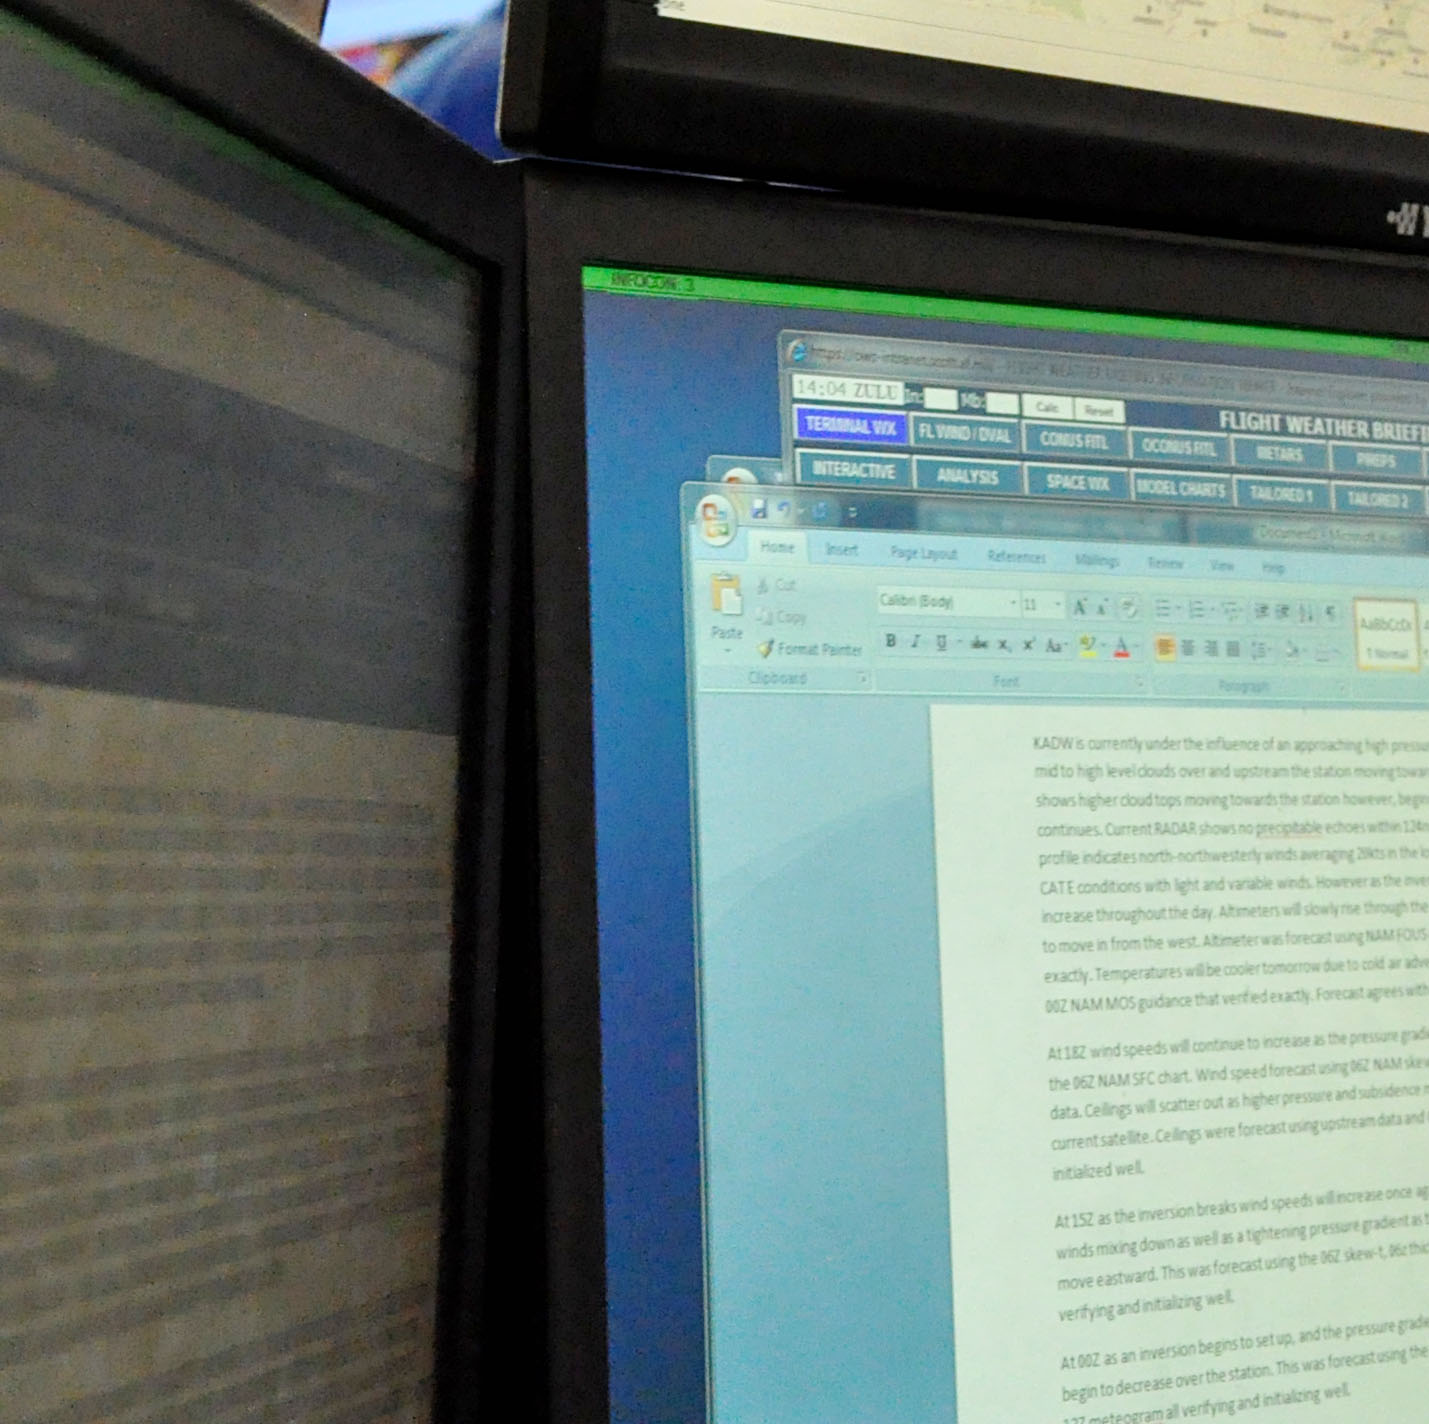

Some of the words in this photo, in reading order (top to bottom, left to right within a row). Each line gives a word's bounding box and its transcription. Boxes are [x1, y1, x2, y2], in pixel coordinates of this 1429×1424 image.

[797, 377, 847, 398] 14:04
[853, 381, 899, 401] ZULU
[805, 414, 872, 436] TERMINAL
[874, 419, 898, 436] WX
[1218, 410, 1282, 433] FLIGHT
[1284, 413, 1371, 440] WEATHER
[1040, 431, 1082, 449] CONUS
[812, 459, 897, 480] INTERACTIVE
[937, 466, 999, 486] ANALYSIS
[1046, 473, 1087, 491] SPACE
[1088, 476, 1111, 492] WX
[1136, 478, 1178, 496] MODEL
[1179, 480, 1226, 498] CHARTS
[760, 540, 796, 555] Home
[825, 542, 859, 556] Insert
[921, 547, 959, 563] Layout
[987, 549, 1047, 565] References
[880, 592, 918, 607] Calibri
[776, 609, 807, 626] Copy
[711, 625, 744, 640] Paste
[777, 641, 820, 657] Format
[822, 643, 864, 657] Painter
[749, 671, 809, 688] Clipboard
[1034, 735, 1073, 749] KADW
[1075, 735, 1085, 750] is
[1087, 735, 1142, 754] currently
[1145, 735, 1180, 750] under
[1035, 763, 1058, 777] mid
[1060, 764, 1074, 777] to
[1076, 763, 1103, 781] high
[1106, 763, 1135, 777] level
[1037, 792, 1075, 807] shows
[1078, 792, 1117, 811] higher
[1119, 792, 1152, 807] cloud
[1105, 820, 1151, 836] Current
[1154, 820, 1196, 835] RADAR
[1039, 849, 1079, 869] profile
[1081, 848, 1136, 864] indicates
[1076, 878, 1141, 894] conditions
[1143, 877, 1171, 892] with
[1041, 907, 1092, 923] increase
[1095, 905, 1166, 925] throughout
[1043, 939, 1055, 953] to
[1058, 940, 1093, 952] move
[1094, 963, 1182, 985] Temperatures
[1070, 995, 1103, 1012] NAM
[1105, 994, 1135, 1010] MOS
[1137, 991, 1192, 1013] guidance
[1047, 1045, 1062, 1060] At
[1090, 1041, 1121, 1058] wind
[1124, 1039, 1167, 1060] speeds
[1048, 1074, 1069, 1090] the
[1097, 1071, 1130, 1088] NAM
[1133, 1069, 1154, 1085] SFC
[1084, 1099, 1132, 1122] Ceilings
[1135, 1098, 1156, 1114] will
[1051, 1134, 1098, 1151] current
[1154, 1125, 1202, 1147] Ceilings
[1053, 1161, 1112, 1181] initialized
[1055, 1213, 1069, 1229] At
[1097, 1213, 1111, 1225] as
[1114, 1207, 1135, 1224] the
[1056, 1241, 1093, 1260] winds
[1096, 1237, 1137, 1260] mixing
[1139, 1234, 1175, 1252] down
[1058, 1275, 1093, 1290] move
[1160, 1263, 1185, 1280] This
[1059, 1301, 1114, 1326] verifying
[1116, 1298, 1140, 1316] and
[1143, 1291, 1203, 1317] initializing
[1061, 1353, 1075, 1370] At
[1103, 1352, 1118, 1366] as
[1120, 1350, 1136, 1364] an
[1062, 1382, 1097, 1406] begin
[1100, 1382, 1113, 1397] to
[1116, 1373, 1172, 1395] decrease
[1175, 1373, 1203, 1388] over
[1166, 1402, 1180, 1419] all
